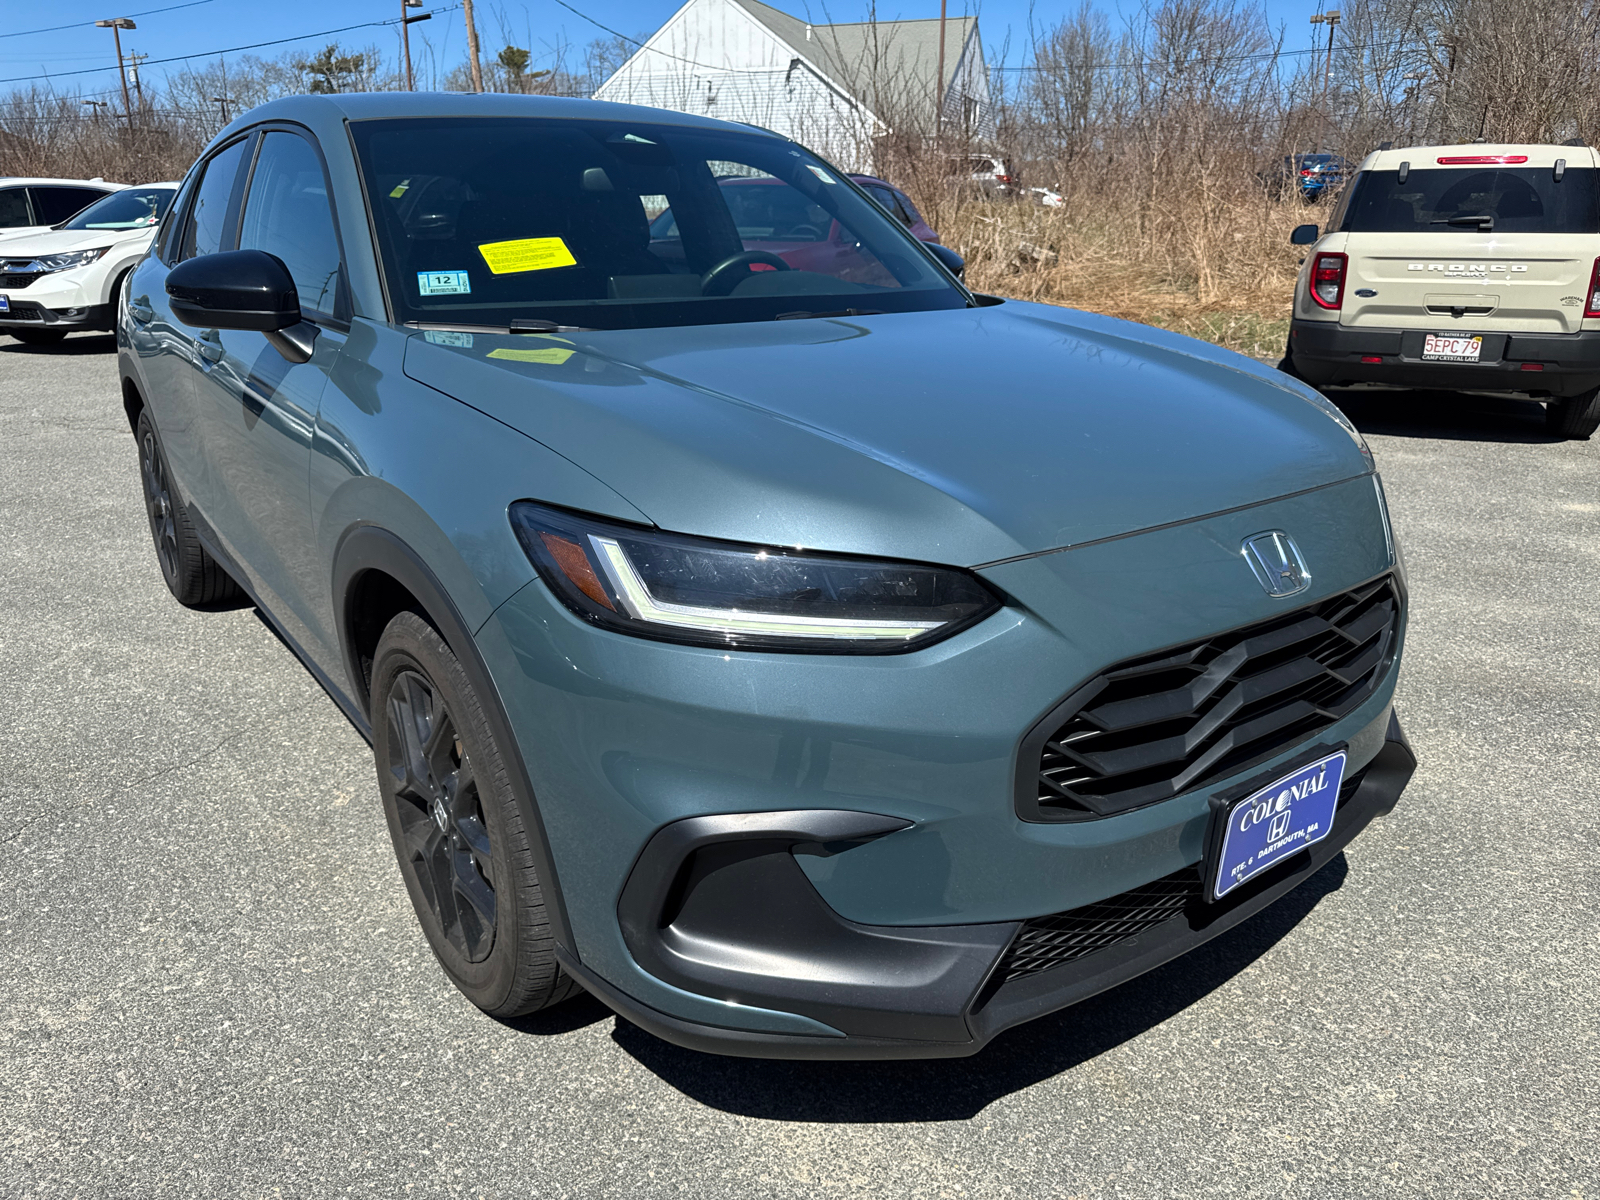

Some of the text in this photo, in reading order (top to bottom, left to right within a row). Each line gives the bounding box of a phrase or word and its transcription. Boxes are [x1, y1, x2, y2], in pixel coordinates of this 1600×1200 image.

[1407, 263, 1528, 272] BRONCO
[435, 276, 452, 285] 12
[1425, 339, 1480, 355] 5EPC 79
[1240, 771, 1329, 832] COLONIAL
[1231, 822, 1319, 877] RTE. 6 DARTMOUTH, MA
